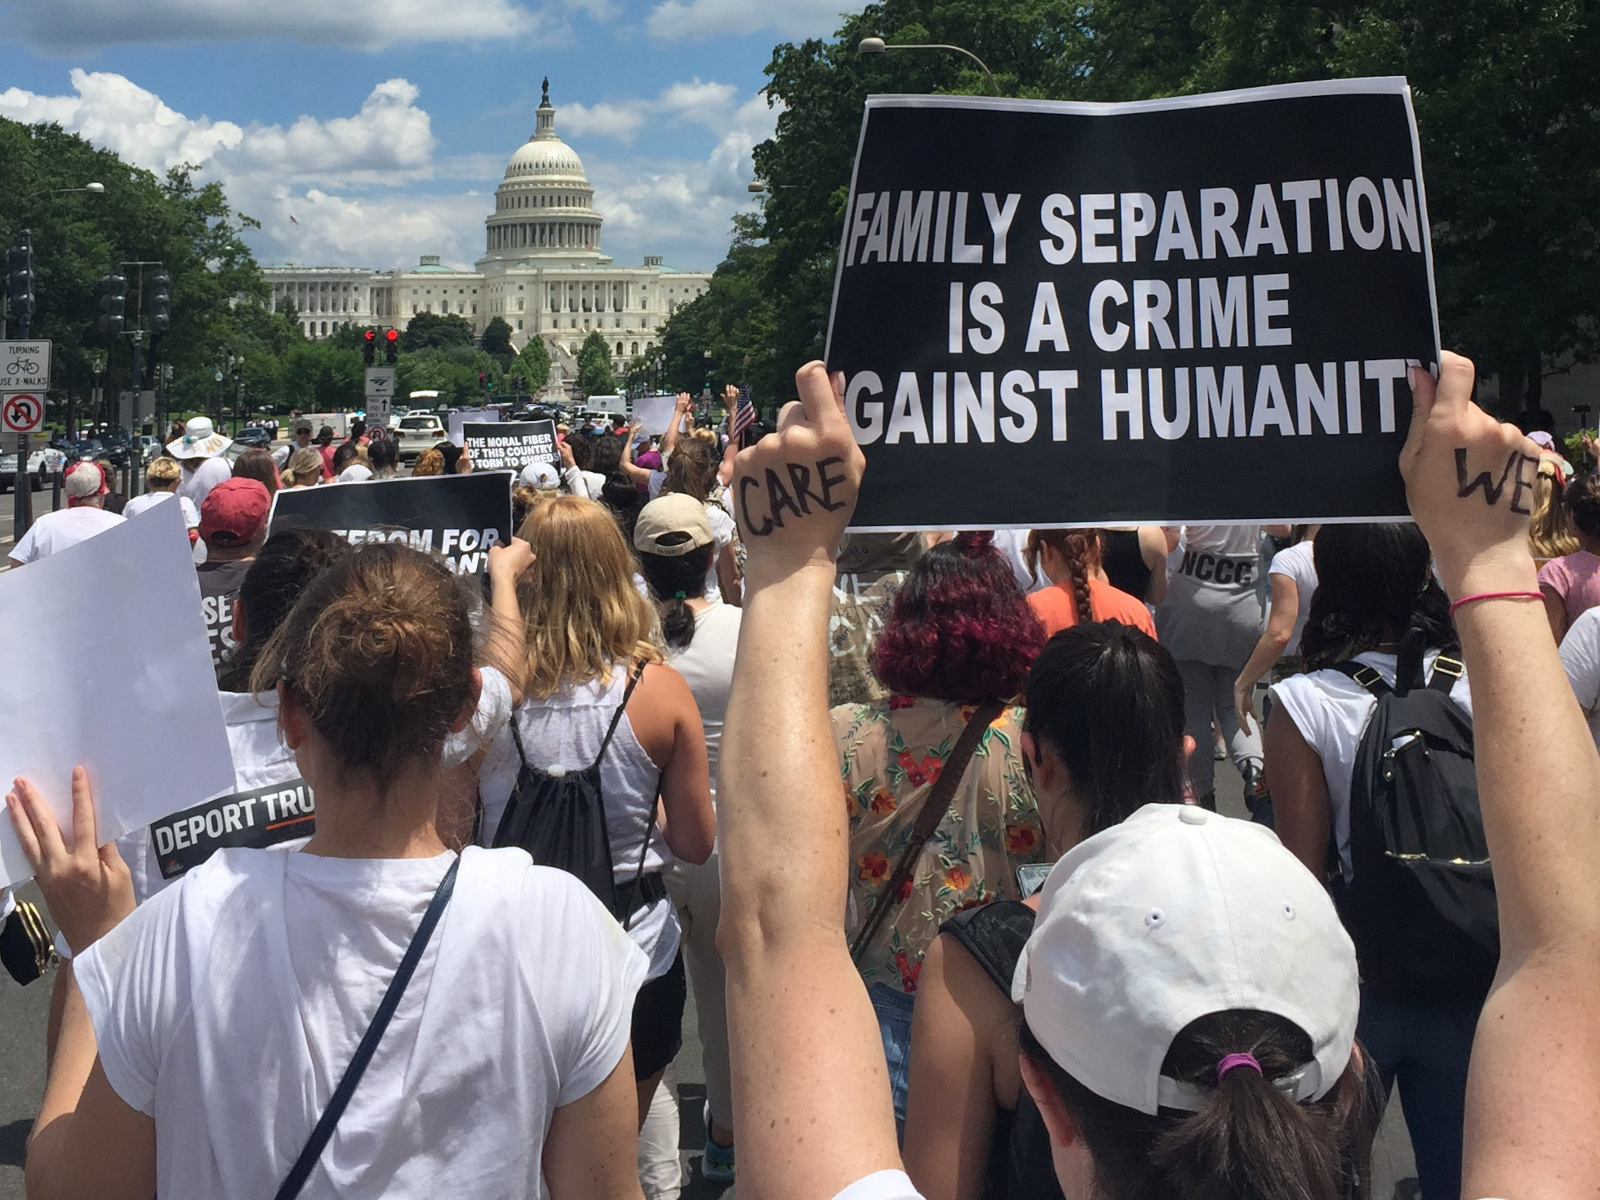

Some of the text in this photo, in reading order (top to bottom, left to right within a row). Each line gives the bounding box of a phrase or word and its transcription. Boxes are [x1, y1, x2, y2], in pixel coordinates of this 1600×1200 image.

[846, 176, 1421, 267] FAMILY SEPARATION
[948, 273, 1292, 355] IS A CRIME
[9, 346, 40, 354] TURNING
[15, 377, 47, 385] X-WALKS
[845, 358, 1437, 445] GAINST HUMANIT
[466, 433, 552, 447] THE MORAL FIBER
[468, 443, 553, 458] OF THIS COUNTRY
[476, 458, 504, 469] TORN
[505, 456, 519, 467] TO
[740, 456, 847, 536] CARE
[1454, 448, 1540, 516] WE
[441, 528, 500, 555] FOR
[155, 785, 315, 856] DEPORT TRU
